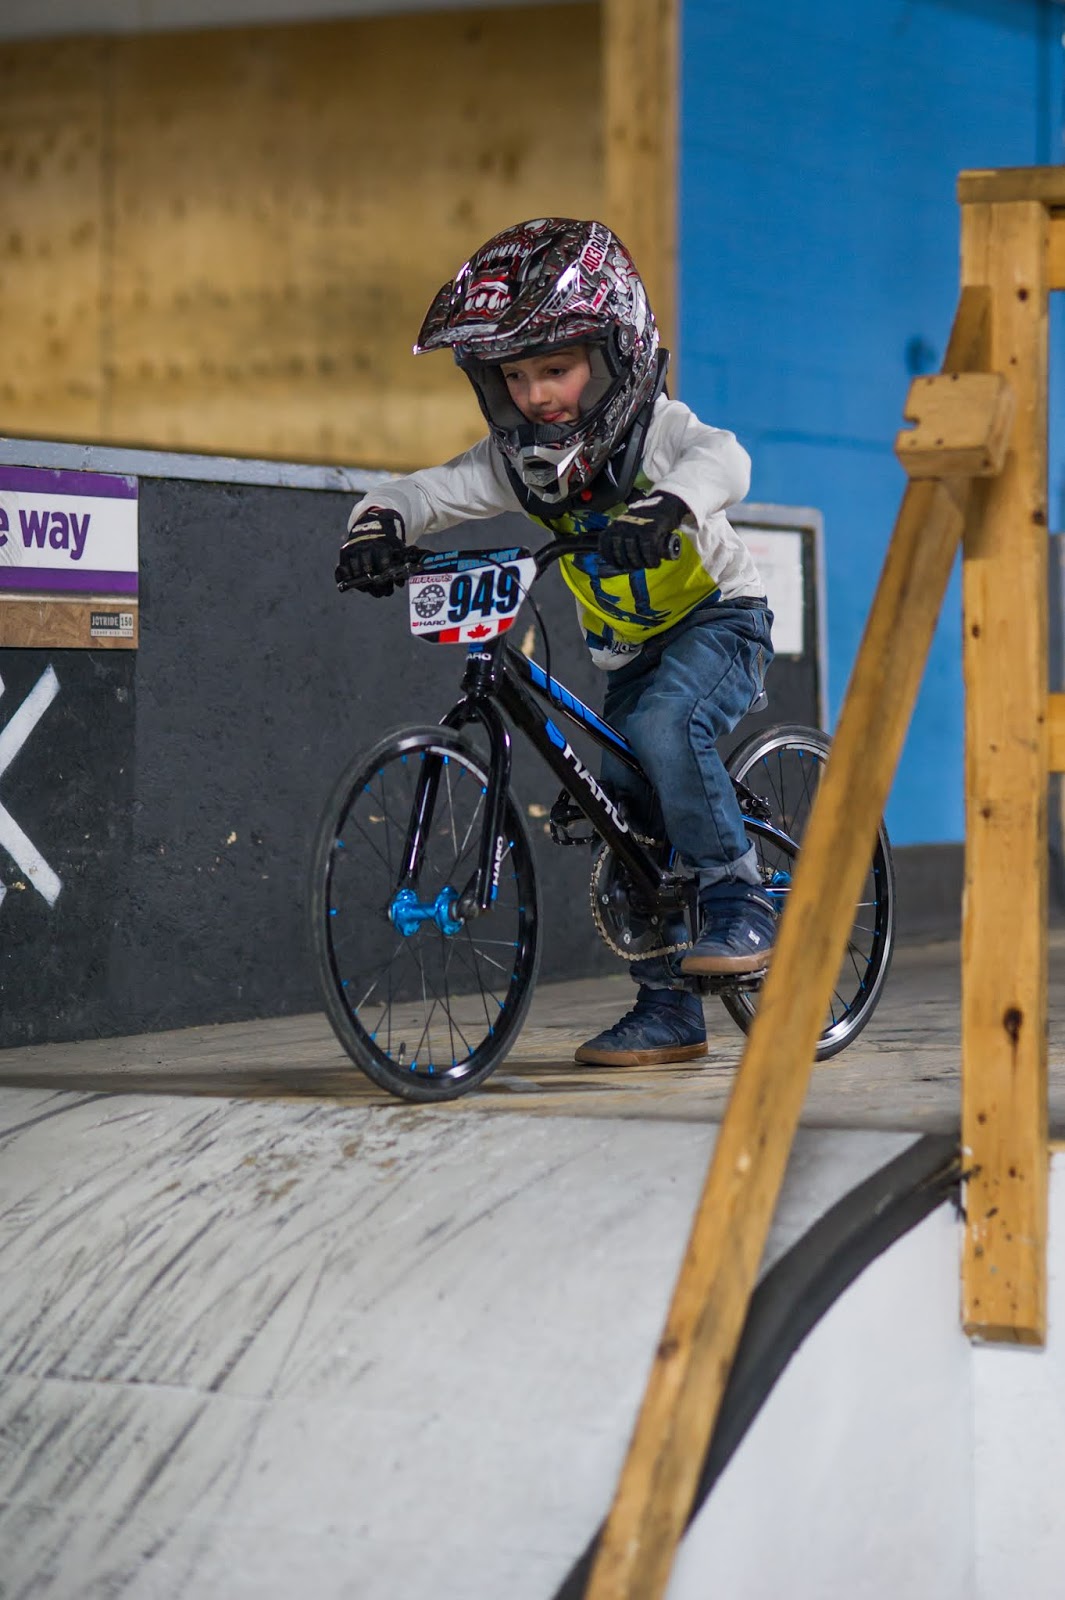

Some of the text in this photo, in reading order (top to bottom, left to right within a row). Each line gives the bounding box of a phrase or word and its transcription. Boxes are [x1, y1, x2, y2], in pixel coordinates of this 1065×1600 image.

[581, 246, 603, 272] 403
[19, 510, 91, 560] way
[447, 565, 520, 623] 949
[91, 615, 132, 627] JOYRIDE 150
[419, 619, 447, 627] HARO
[492, 835, 503, 886] HARO
